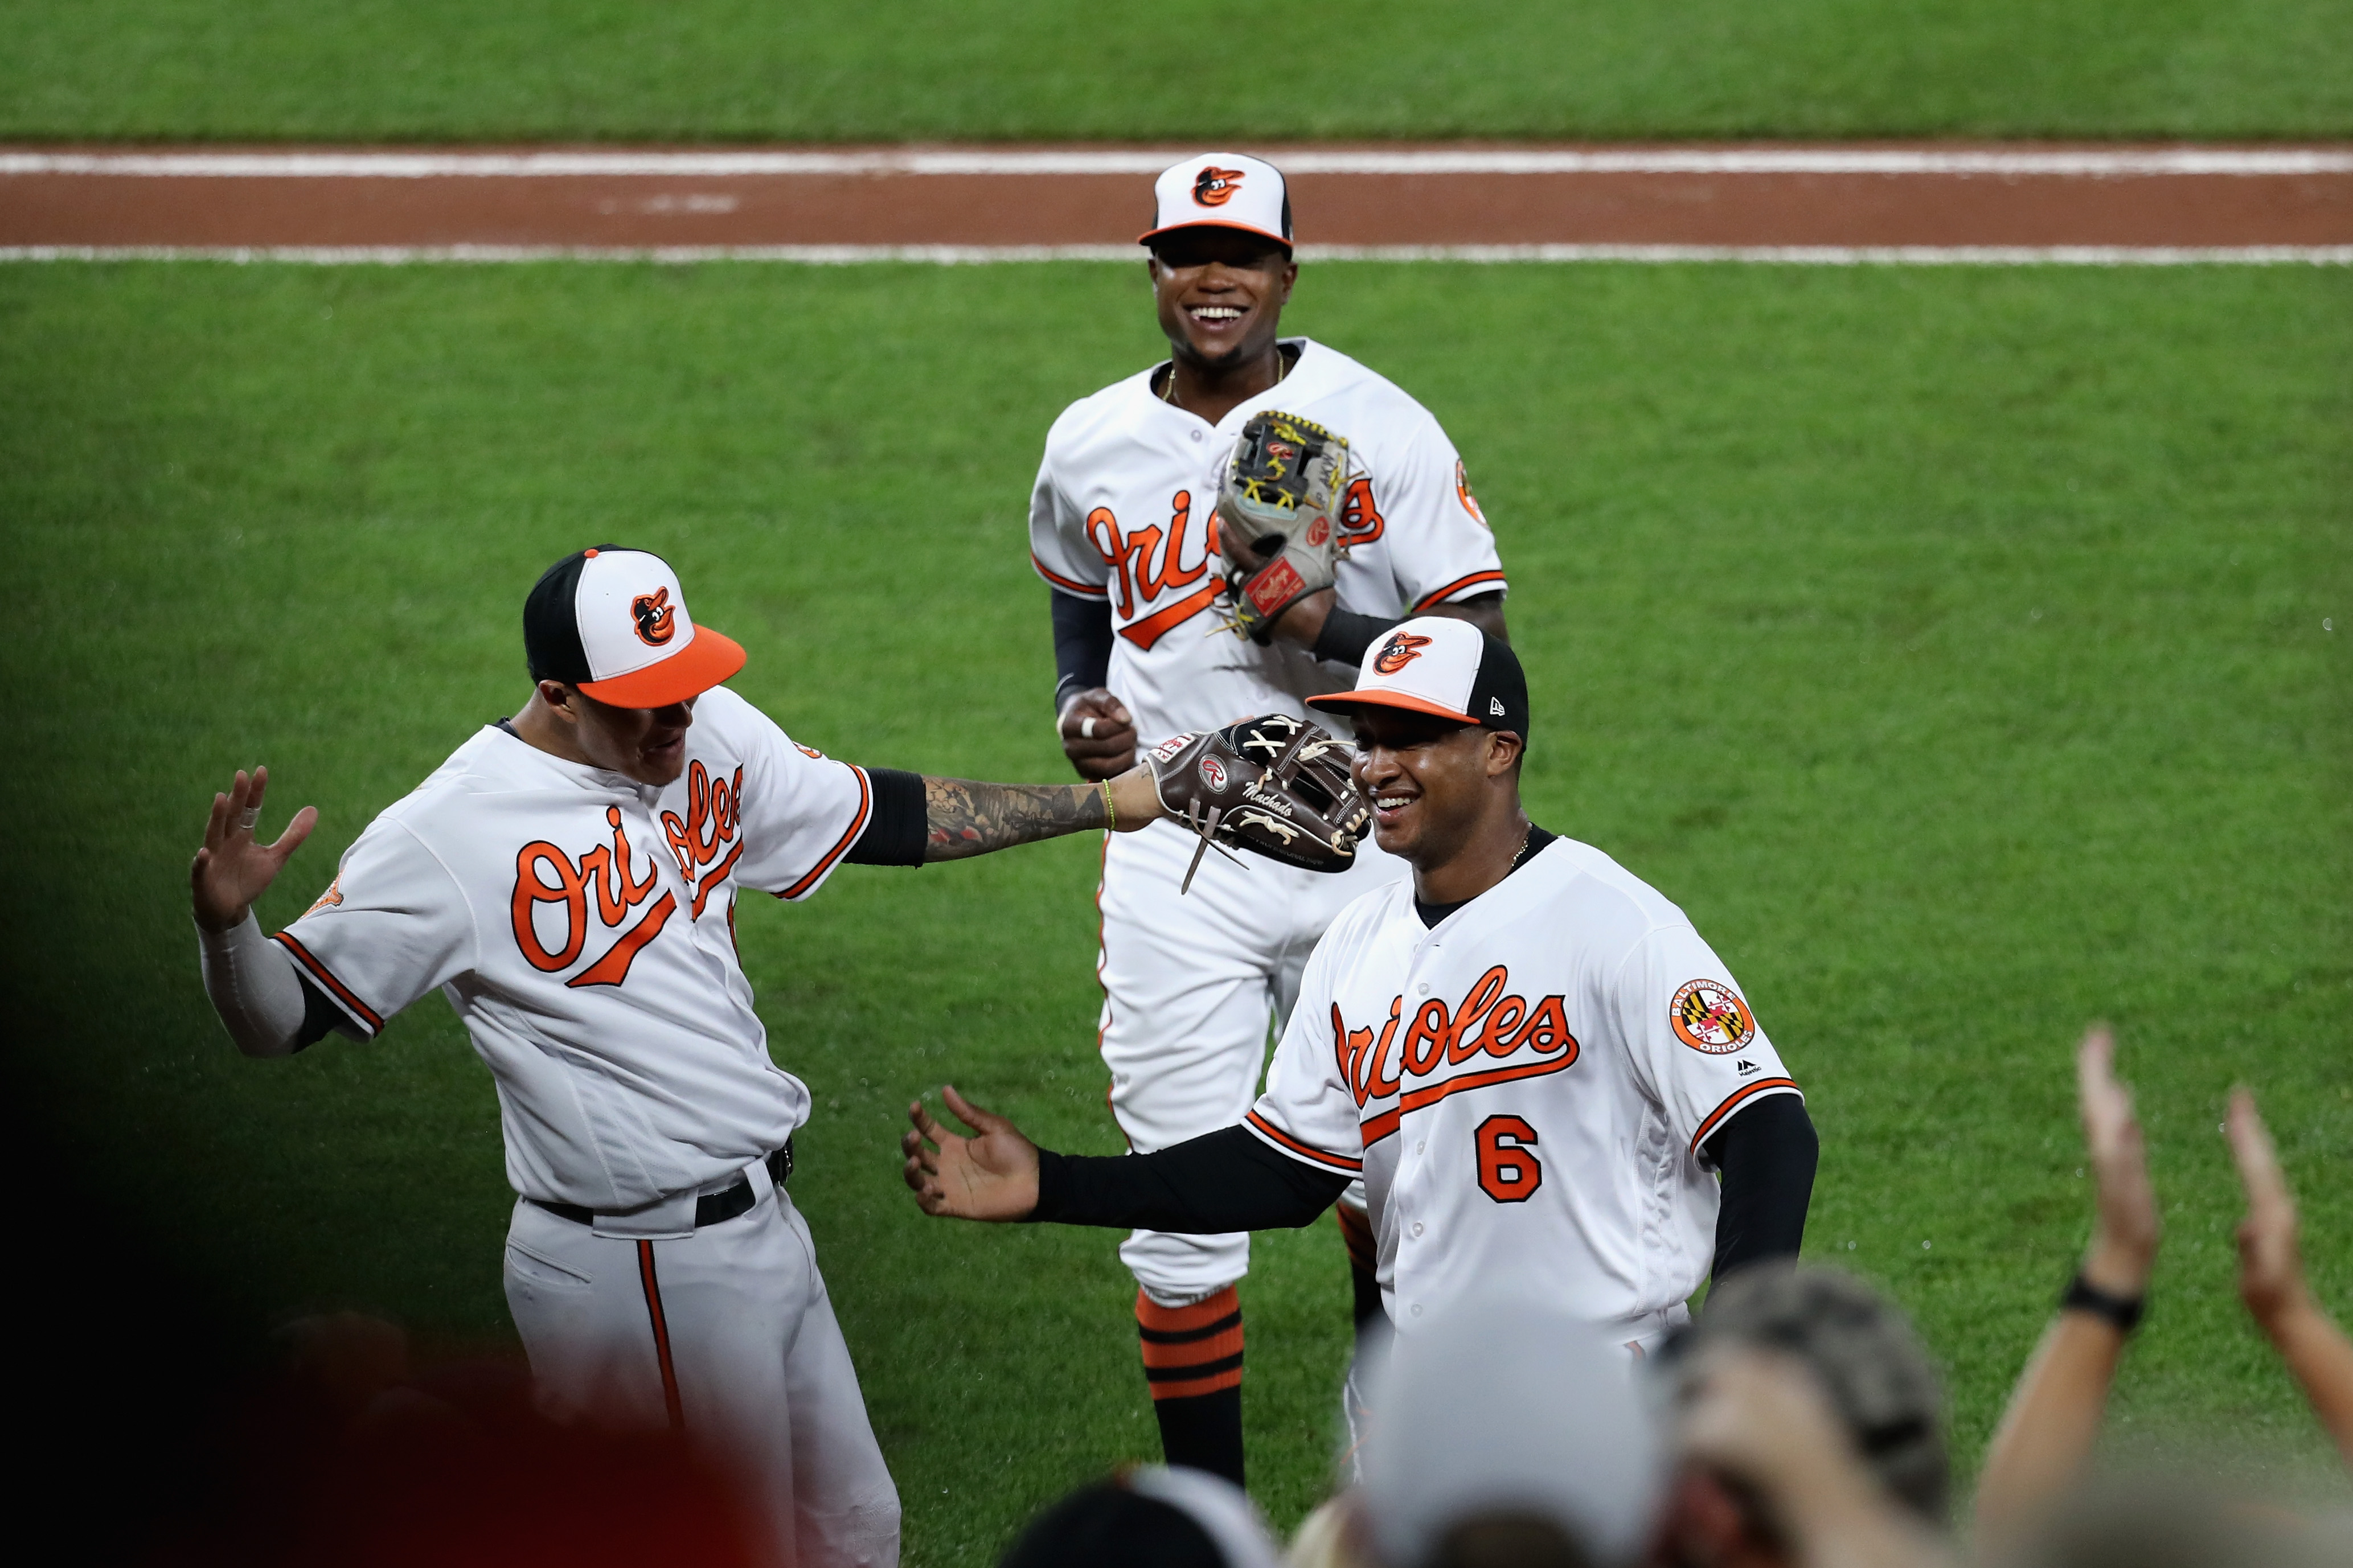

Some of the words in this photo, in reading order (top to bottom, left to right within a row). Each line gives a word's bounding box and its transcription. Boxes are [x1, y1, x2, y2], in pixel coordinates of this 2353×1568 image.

[1242, 781, 1293, 817] Machado
[1671, 980, 1736, 1017] BALTIMORE
[1331, 964, 1580, 1109] rioles
[1699, 1029, 1753, 1053] ORIOLES
[1474, 1114, 1542, 1204] 6
